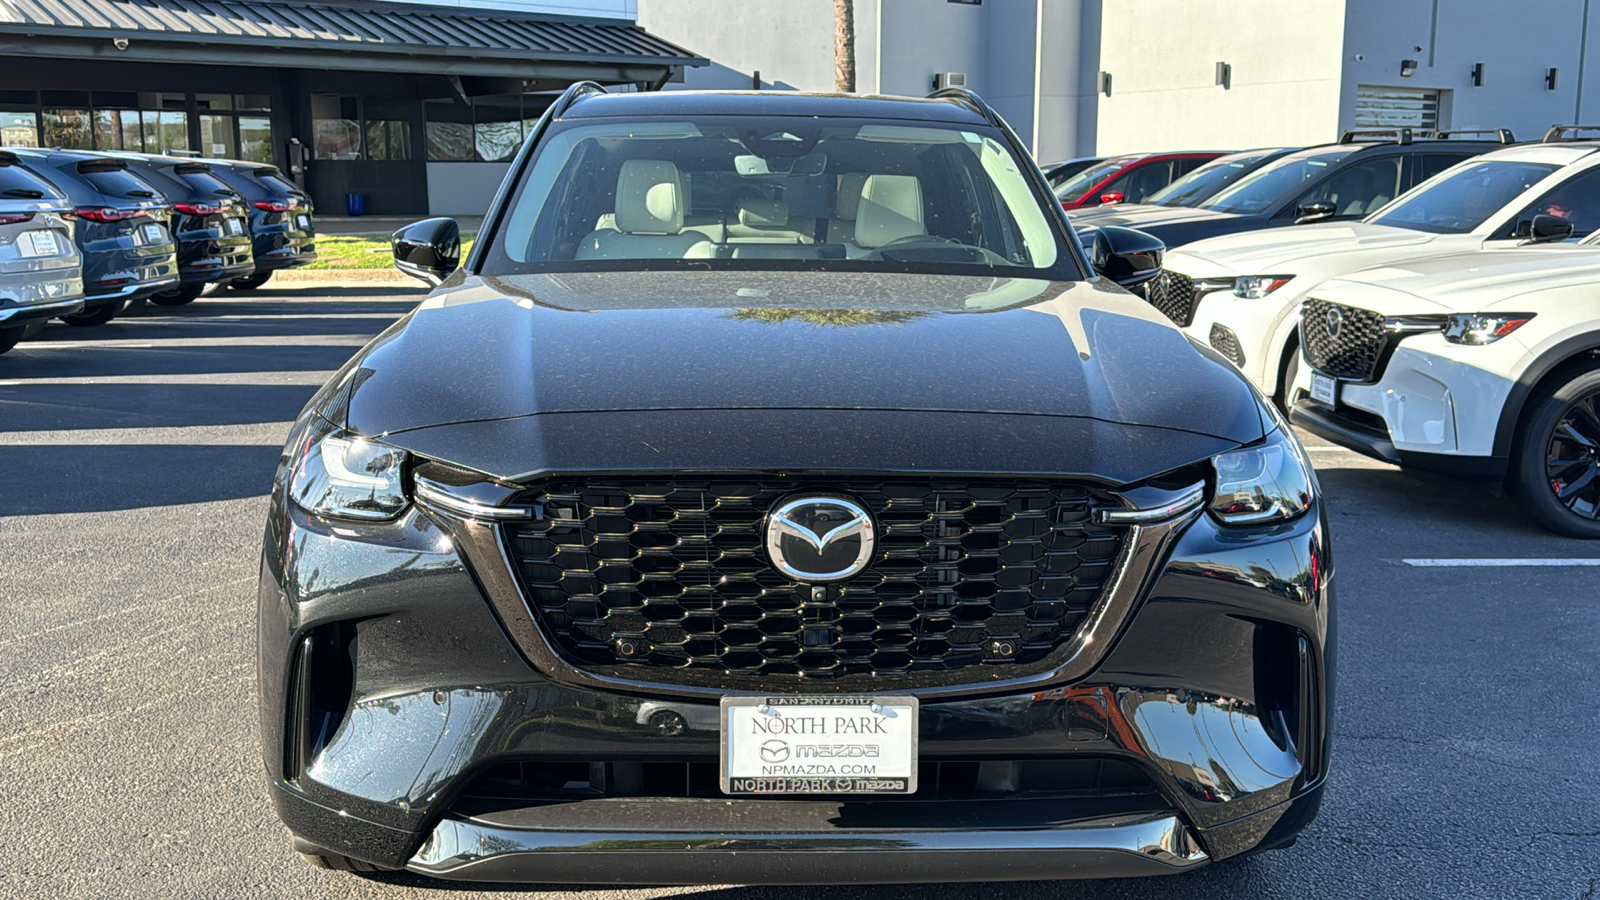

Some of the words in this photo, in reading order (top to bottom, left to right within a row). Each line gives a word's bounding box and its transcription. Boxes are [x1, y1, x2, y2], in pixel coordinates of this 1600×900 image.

[751, 717, 825, 735] NORTH
[834, 717, 888, 734] PARK
[796, 744, 880, 758] mazda
[762, 765, 876, 774] NPMAZDA.COM
[733, 779, 786, 792] NORTH
[793, 779, 831, 792] PARK
[856, 780, 904, 790] mazda
